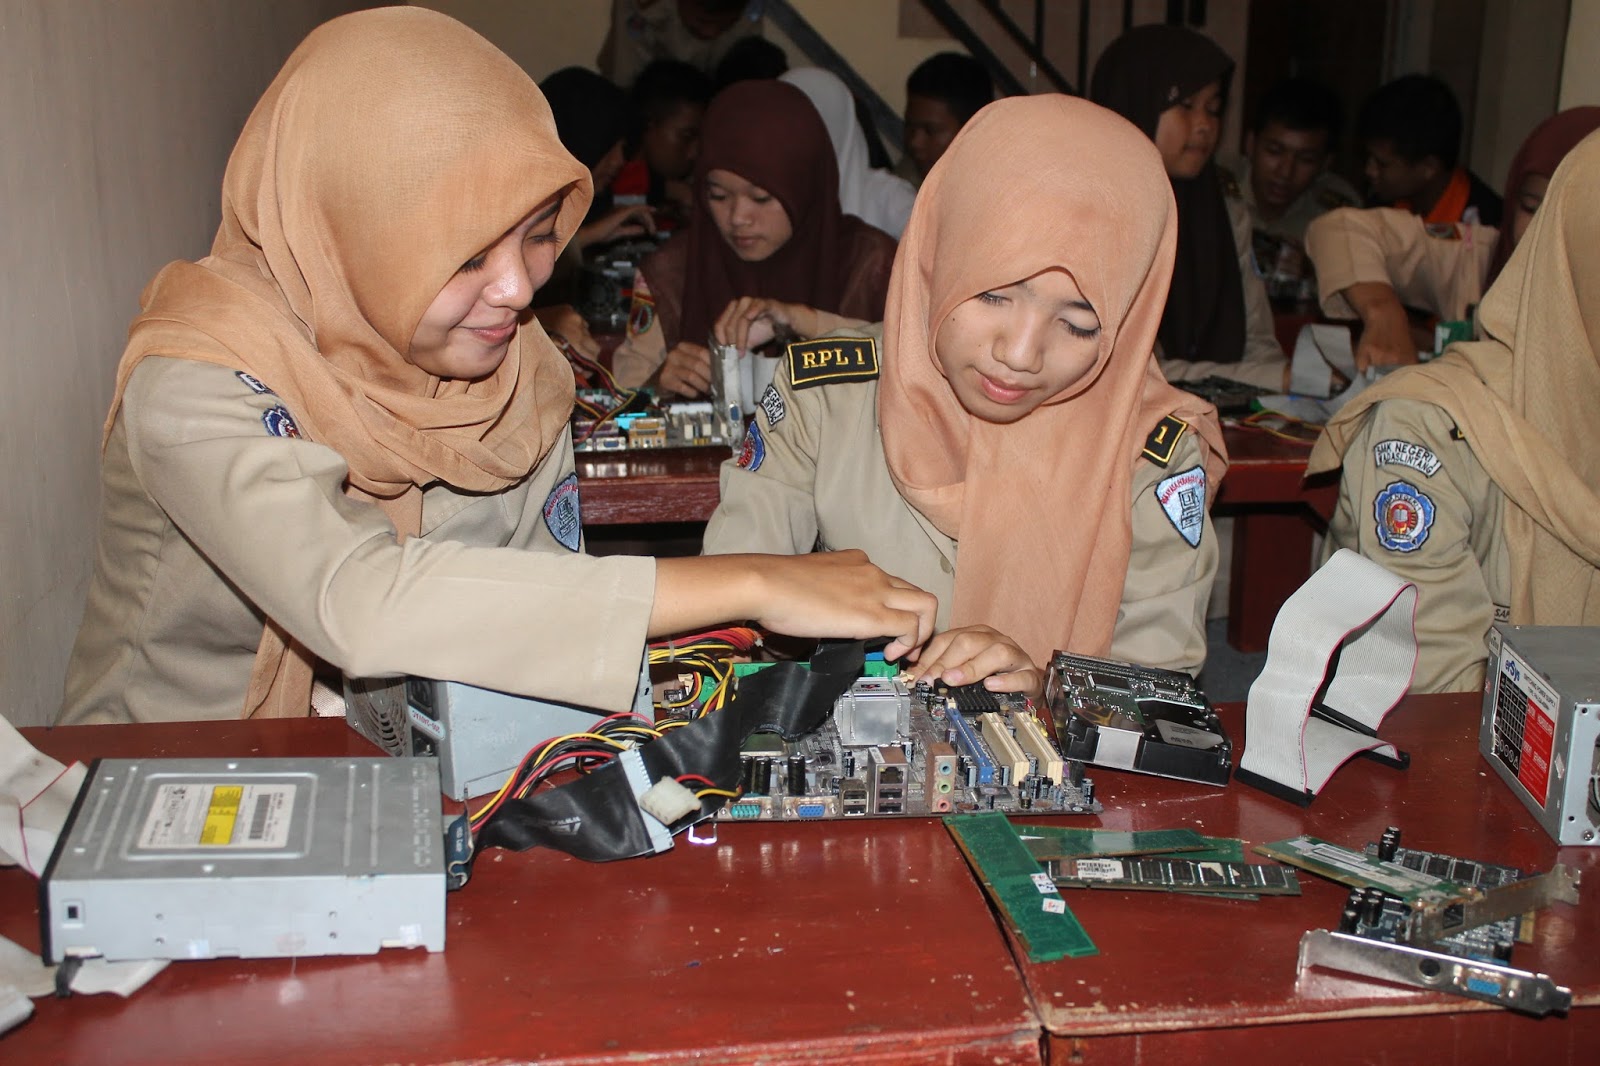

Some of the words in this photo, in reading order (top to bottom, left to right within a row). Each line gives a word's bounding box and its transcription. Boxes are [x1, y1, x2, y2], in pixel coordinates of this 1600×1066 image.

[801, 348, 849, 369] RPL
[854, 347, 866, 365] 1
[1154, 425, 1168, 444] 1
[1395, 442, 1433, 461] NEGERI
